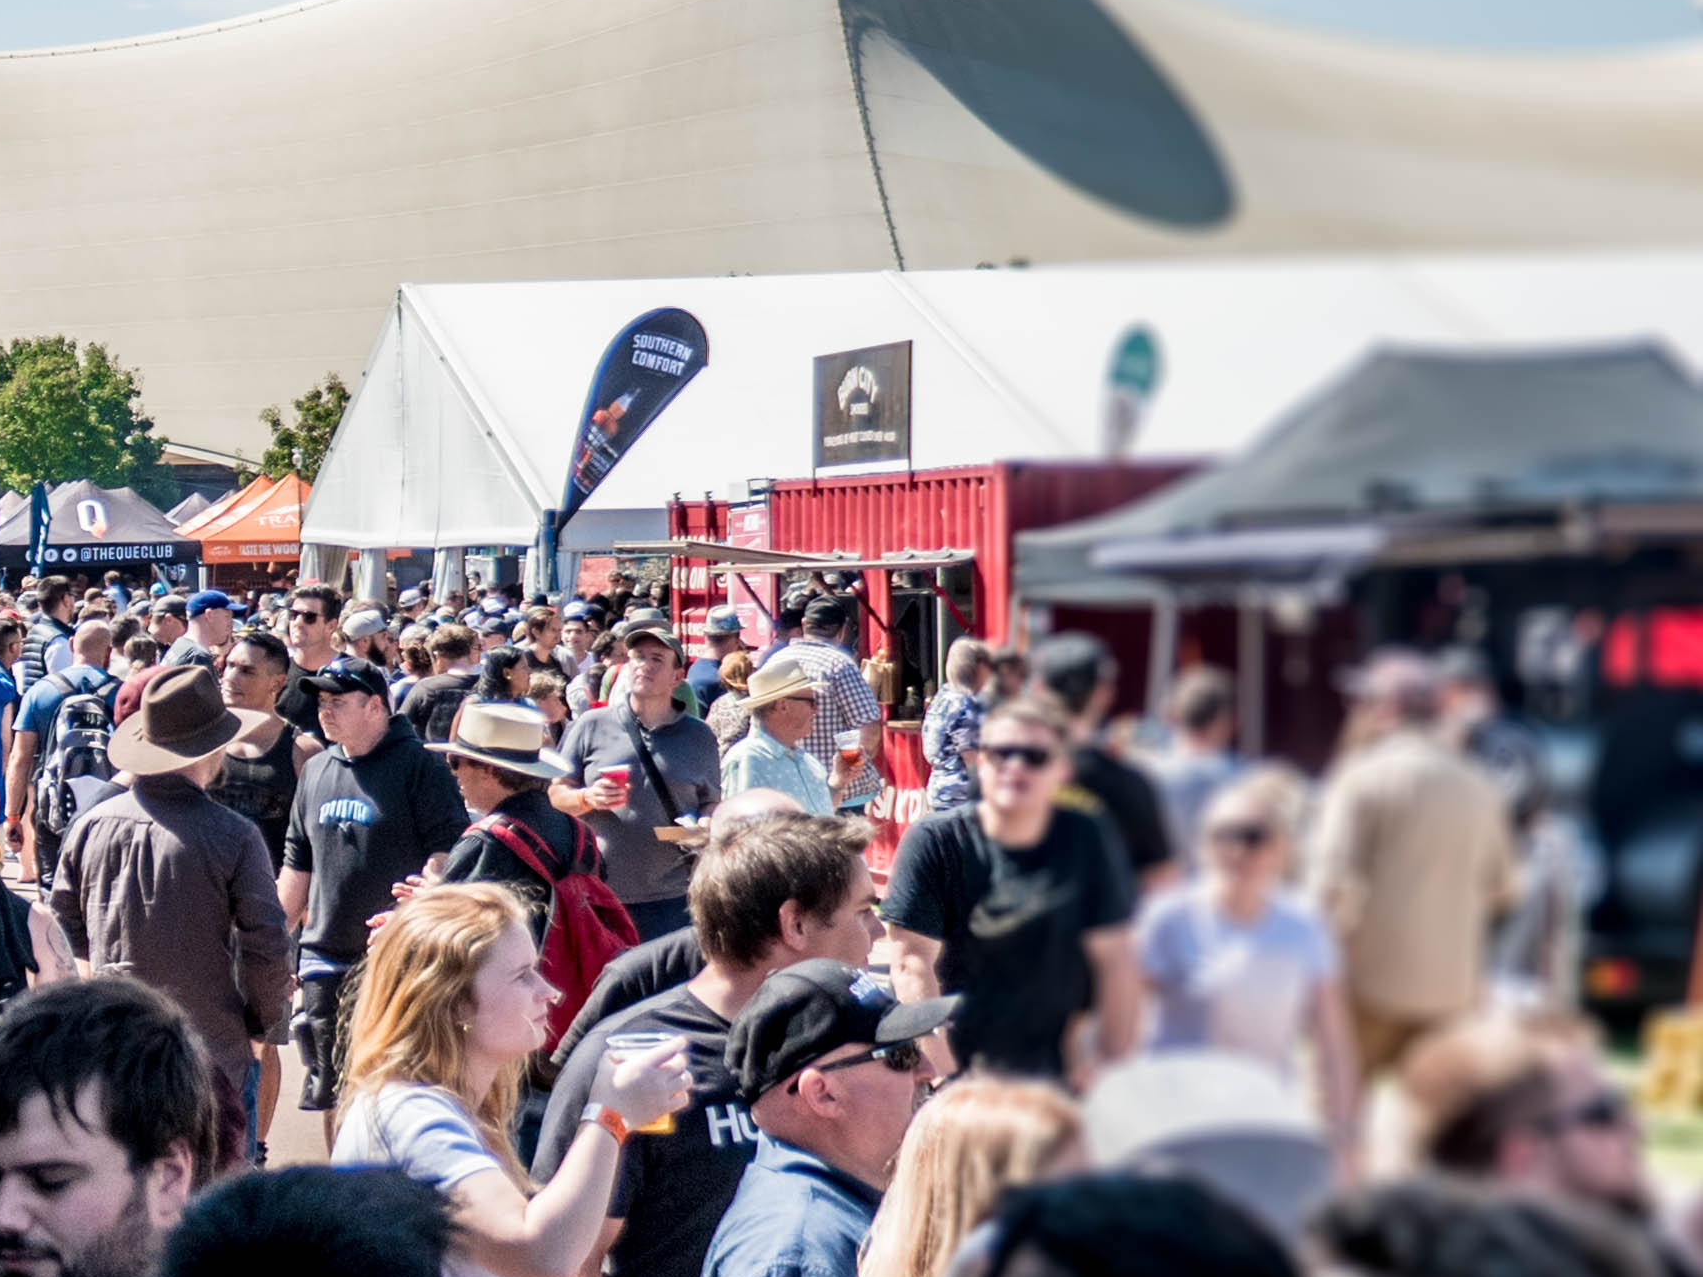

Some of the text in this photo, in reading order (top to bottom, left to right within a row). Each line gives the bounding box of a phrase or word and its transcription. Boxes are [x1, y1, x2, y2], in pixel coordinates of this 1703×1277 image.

[632, 333, 693, 361] SOUTHERN
[632, 351, 686, 377] COMFORT
[80, 544, 174, 563] @THEQUECLUB
